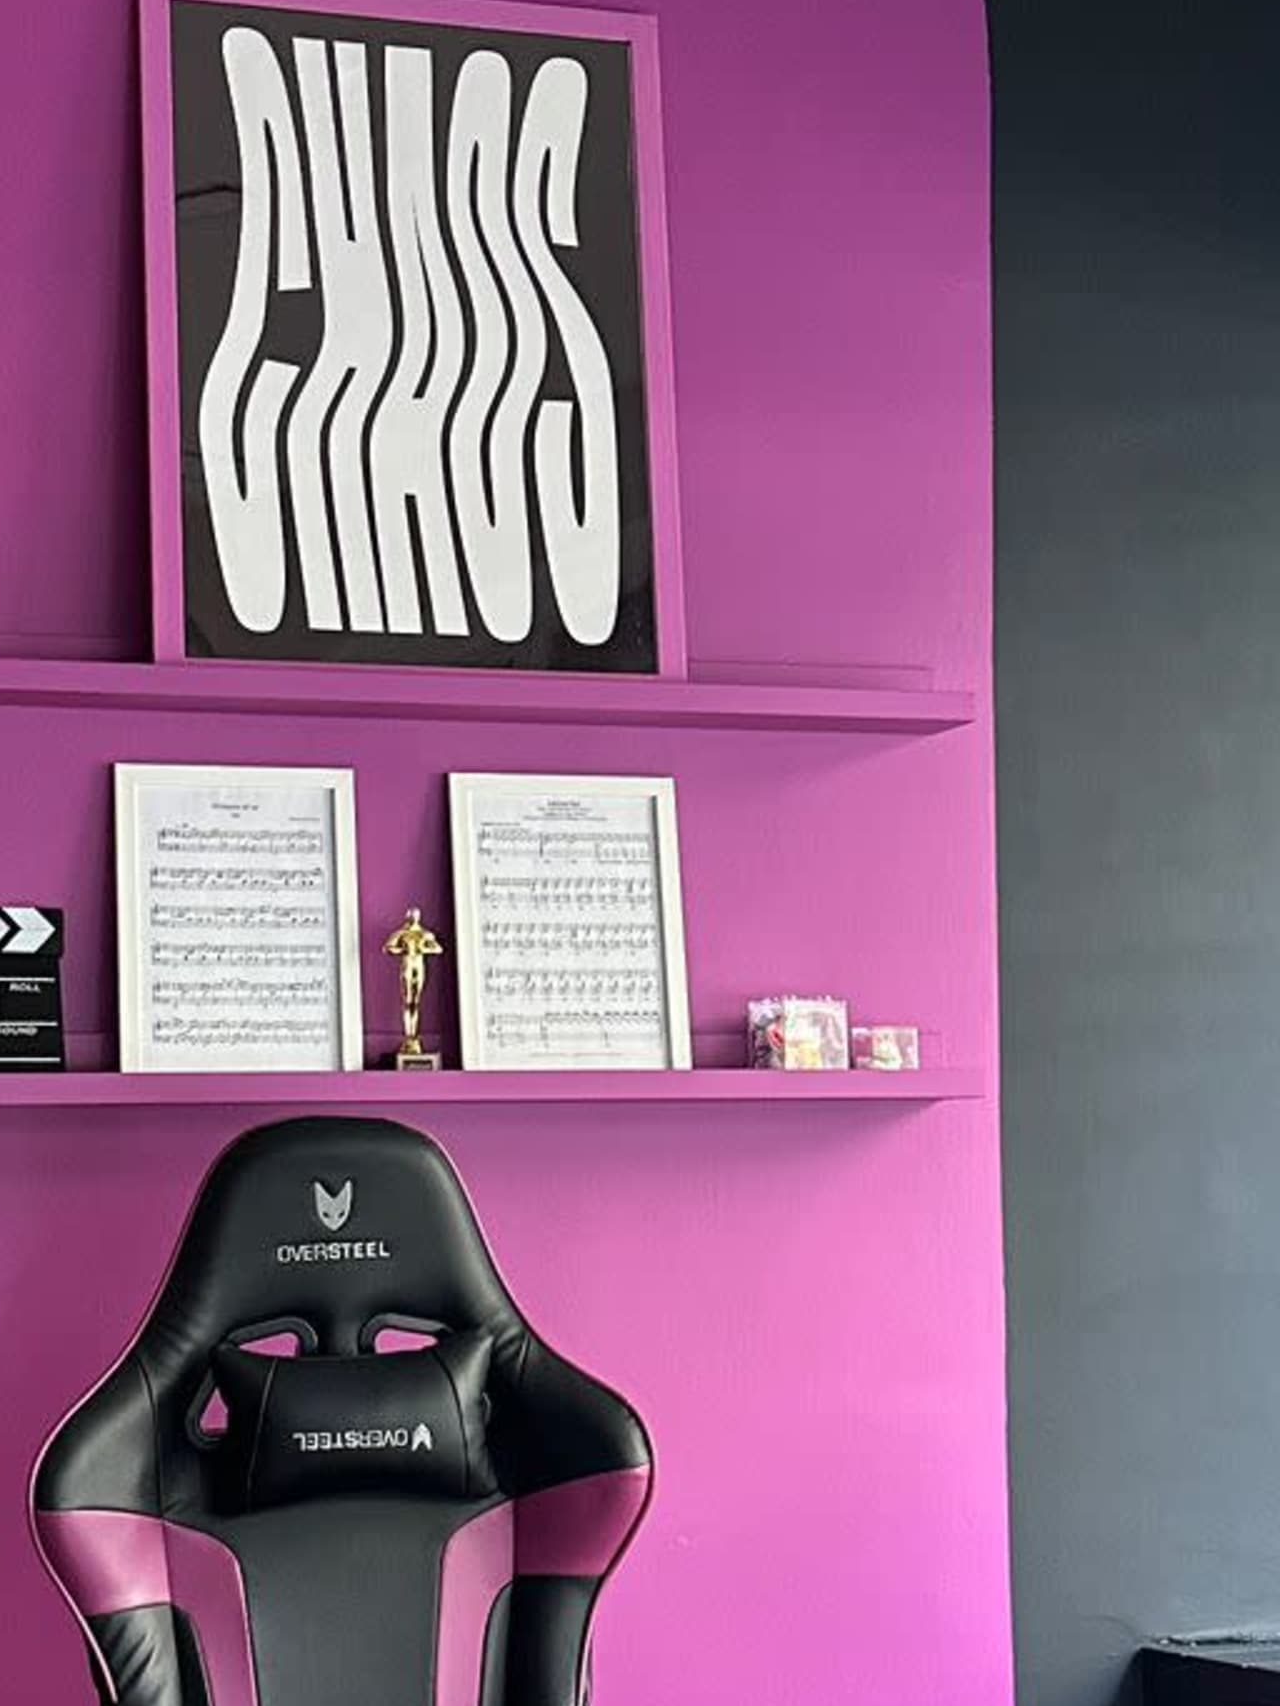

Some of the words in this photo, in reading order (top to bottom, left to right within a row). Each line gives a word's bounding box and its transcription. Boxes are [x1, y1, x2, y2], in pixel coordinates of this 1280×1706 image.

[198, 25, 621, 646] CHAOS
[9, 982, 41, 992] ROLL
[277, 1241, 391, 1263] OVERSTEEL
[292, 1428, 408, 1452] OVERSTEEL
